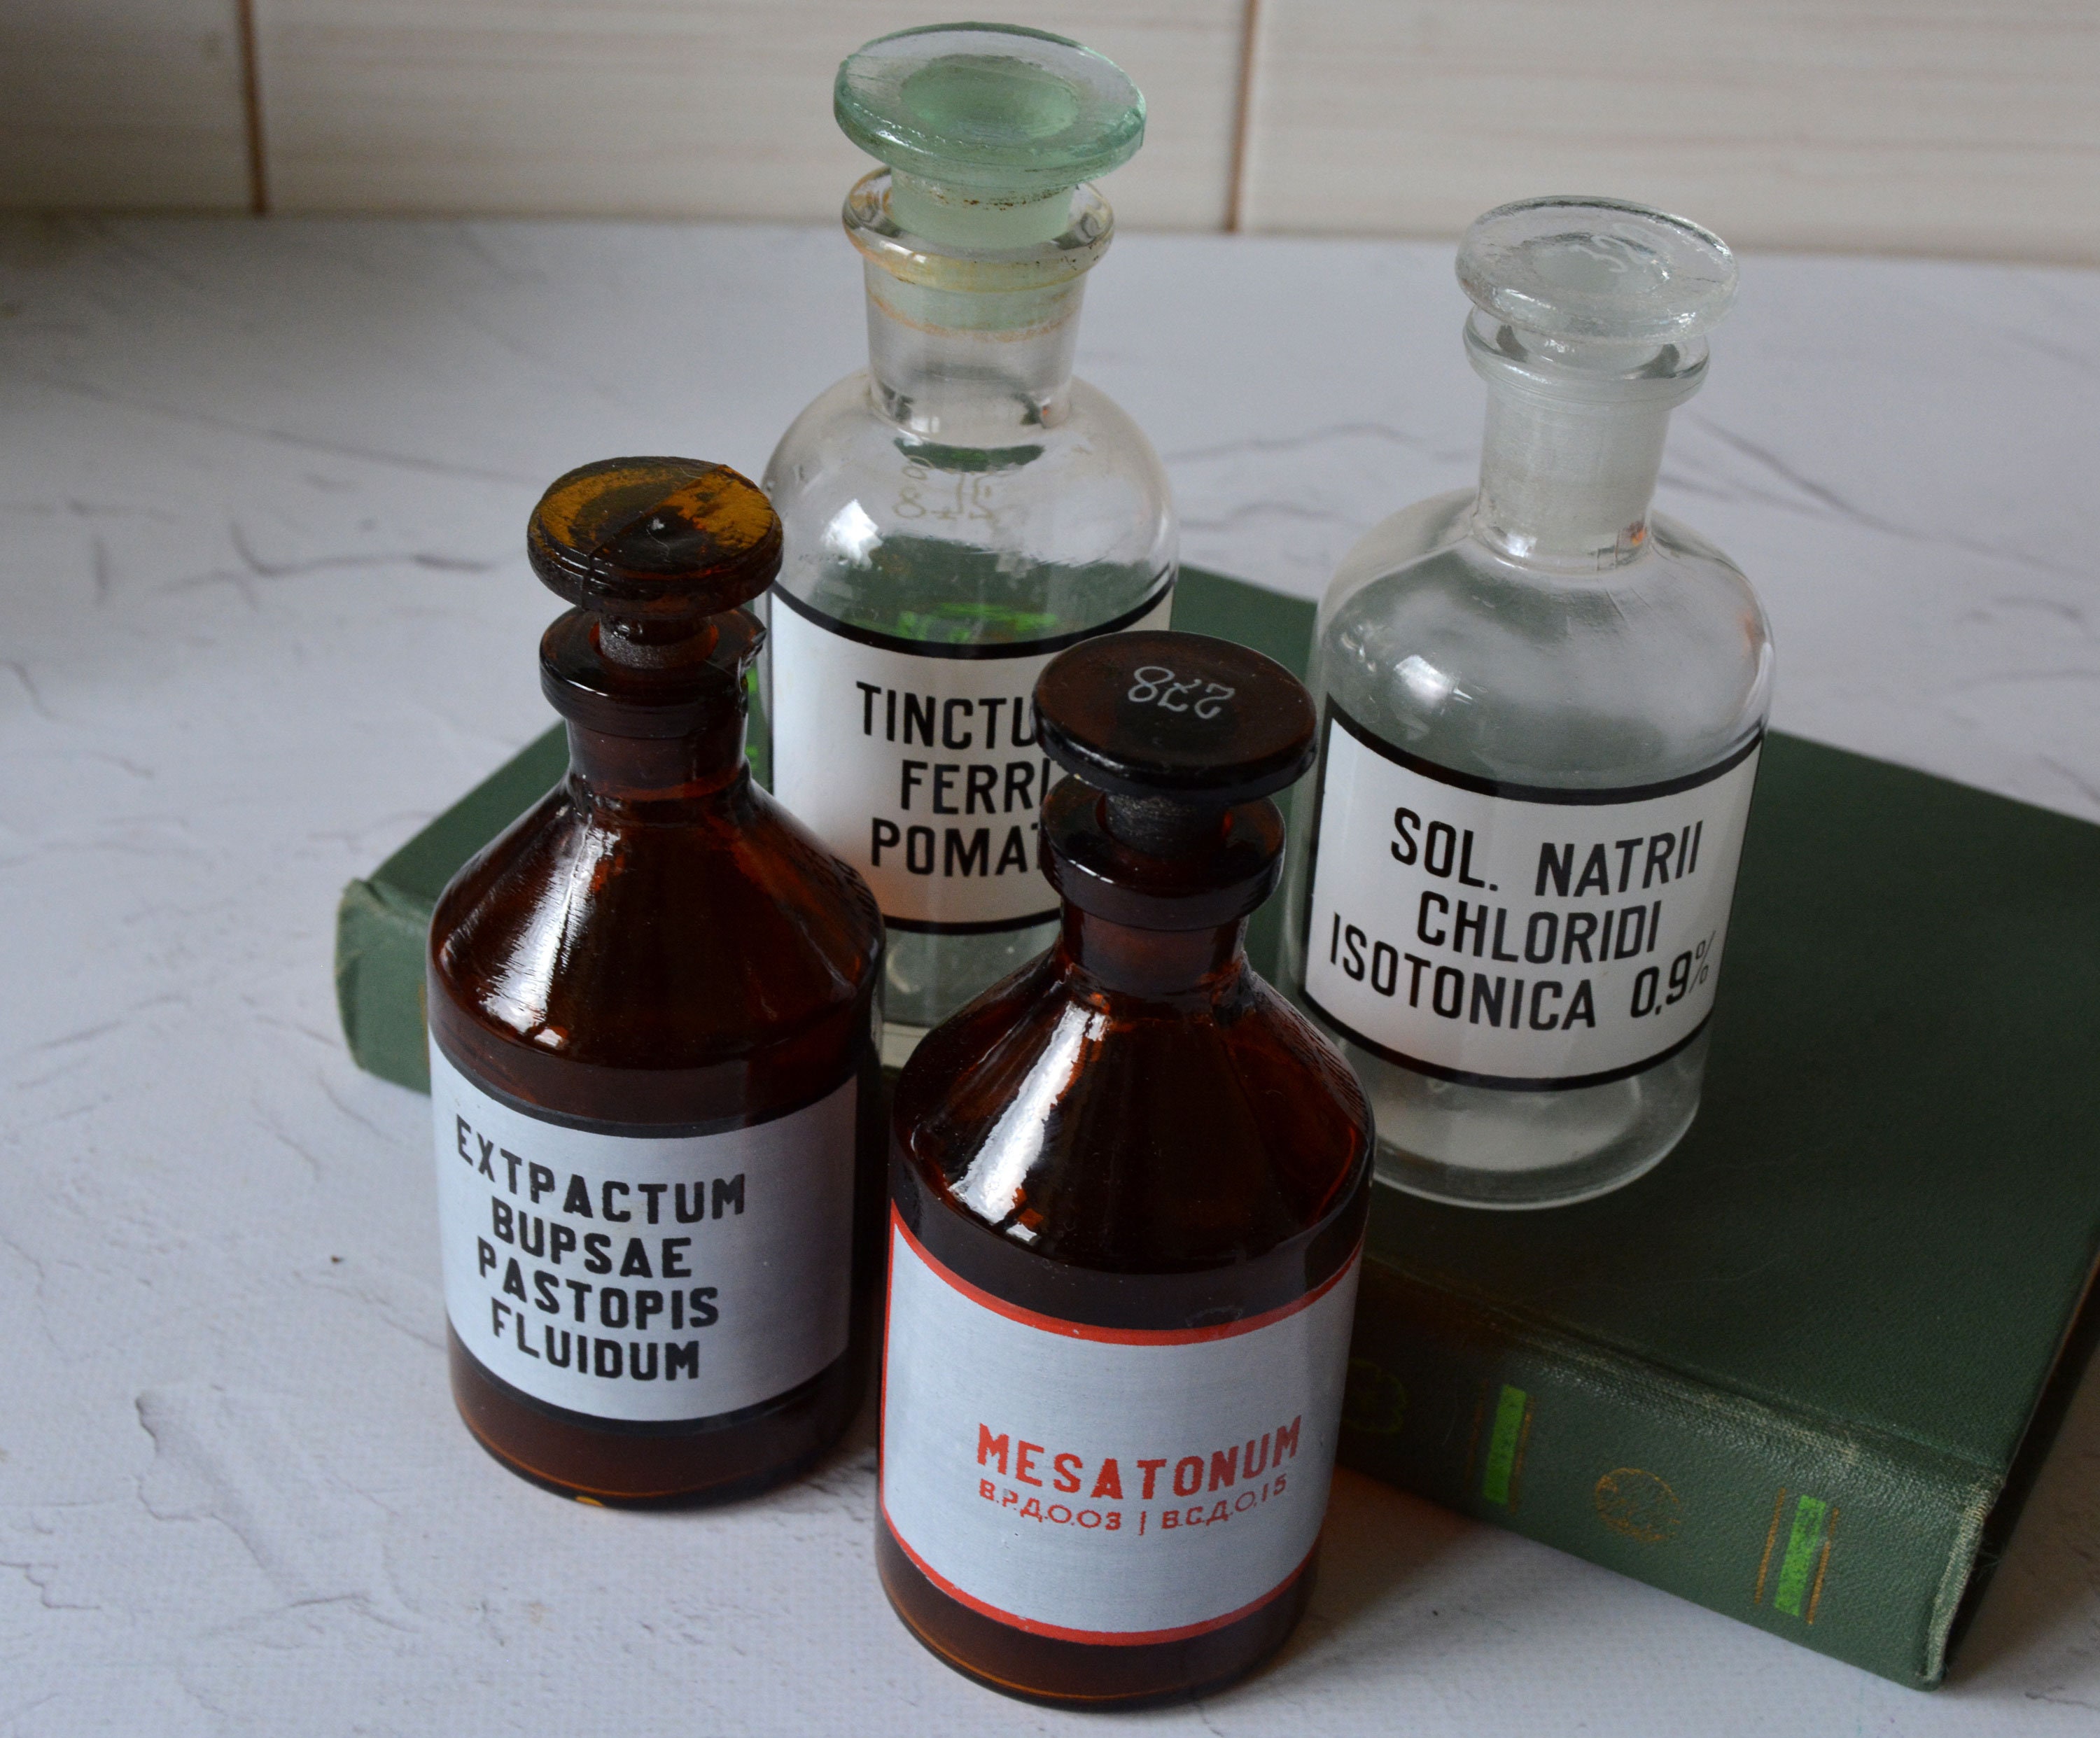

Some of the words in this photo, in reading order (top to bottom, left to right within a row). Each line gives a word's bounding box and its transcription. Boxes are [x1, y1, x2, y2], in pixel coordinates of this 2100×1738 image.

[900, 757, 1050, 816] FERRI
[870, 817, 1039, 879] POMA
[1390, 806, 1499, 892] SOL.
[1534, 820, 1704, 898] NATRII
[1417, 890, 1662, 965] CHLORIDI
[1330, 912, 1597, 1031] ISOTONICA
[456, 1114, 746, 1225] EXTPACTUM
[491, 1196, 692, 1279] BUPSAE
[477, 1236, 720, 1331] PASTOPIS
[491, 1297, 700, 1382] FLUIDUM
[977, 1415, 1302, 1500] MESATONUM
